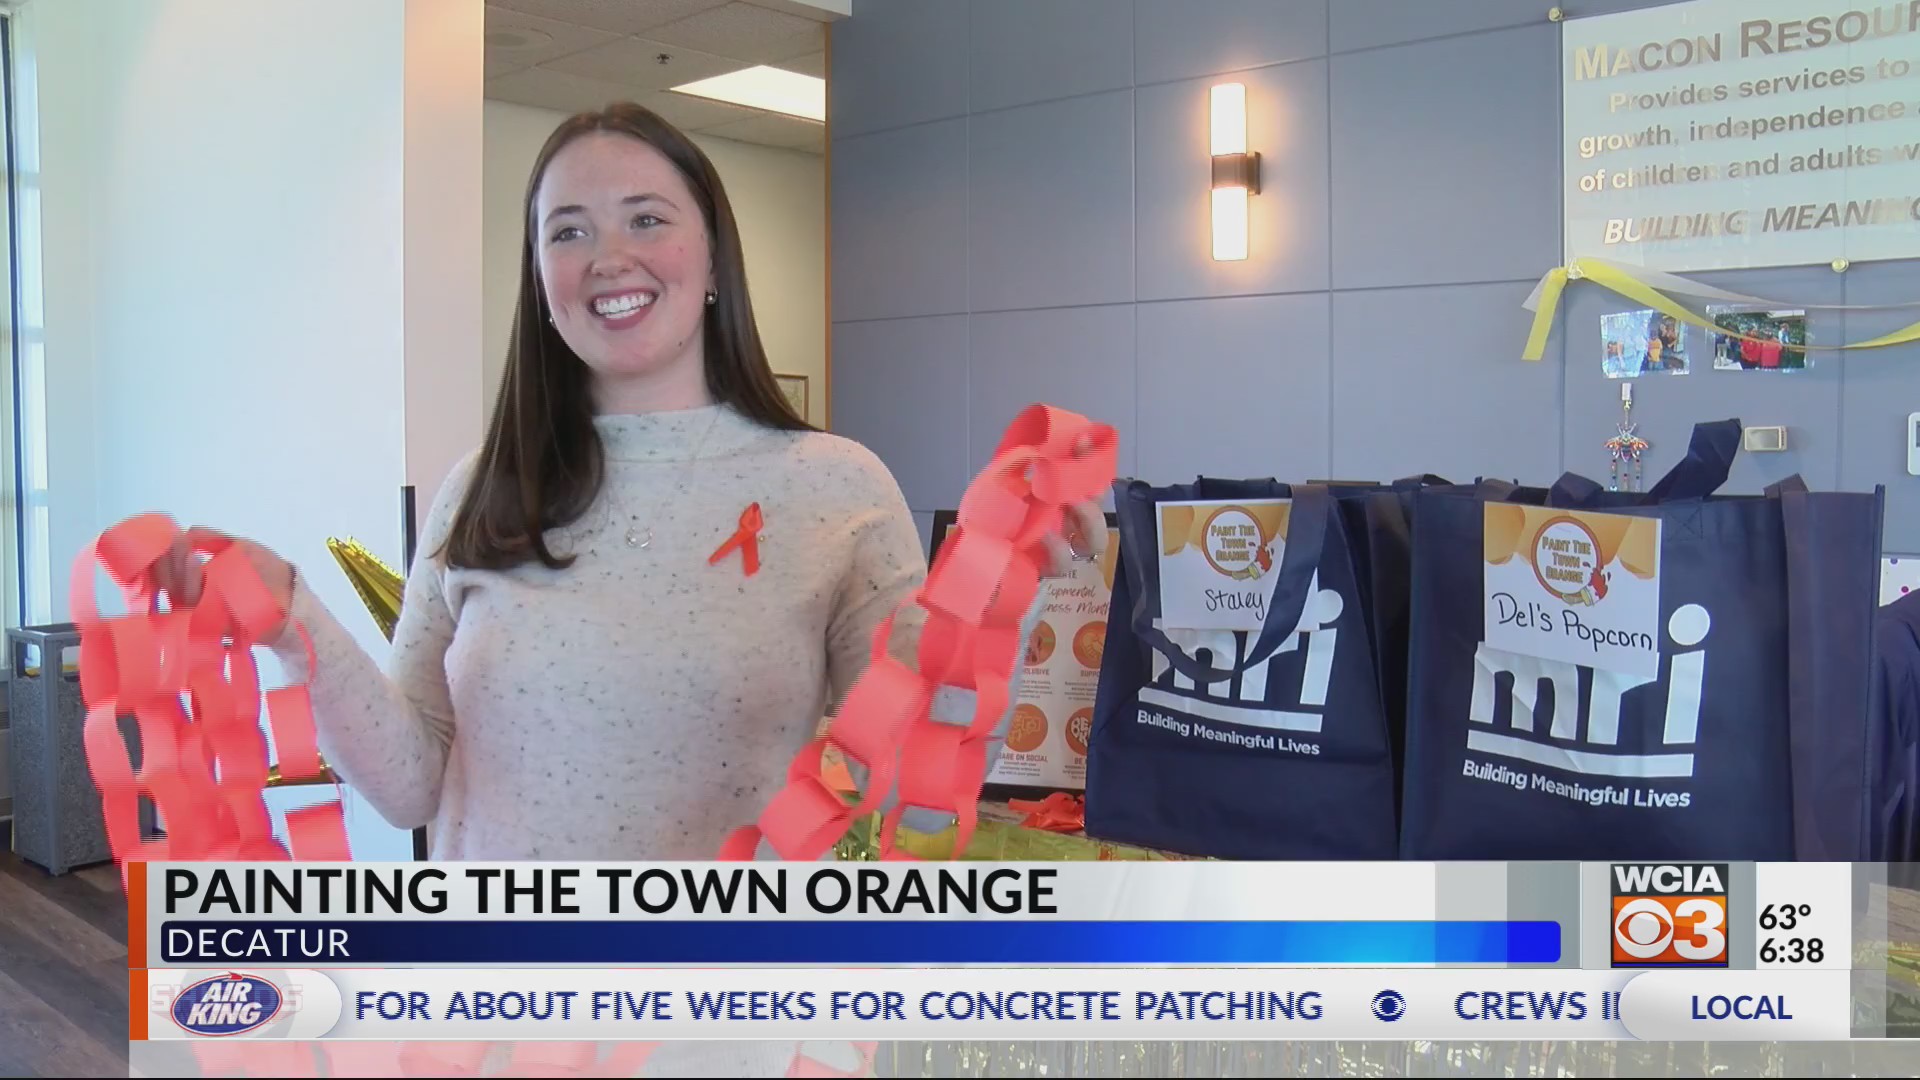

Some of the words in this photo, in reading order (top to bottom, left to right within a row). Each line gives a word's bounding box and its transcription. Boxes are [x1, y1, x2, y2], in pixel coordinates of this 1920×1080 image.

[1575, 33, 1721, 81] MACON
[1609, 82, 1728, 113] Provides
[1739, 68, 1865, 98] services
[1876, 58, 1910, 80] to
[1579, 125, 1679, 158] growth,
[1689, 101, 1906, 141] independence
[1579, 169, 1605, 192] of
[1612, 163, 1720, 190] children
[1728, 153, 1779, 179] and
[1789, 145, 1883, 173] adults
[1604, 209, 1749, 244] BUILDING
[1552, 552, 1580, 568] TOWN
[1573, 540, 1591, 555] THE
[1546, 566, 1583, 584] ORANGE
[1205, 589, 1265, 622] Staley
[1492, 592, 1553, 632] Del's
[1562, 609, 1653, 652] Popcorn
[1469, 603, 1712, 745] mri
[1137, 709, 1190, 737] Building
[1193, 724, 1275, 750] Meaningful
[1278, 737, 1321, 756] Lives
[1462, 759, 1528, 790] Building
[1531, 773, 1630, 806] Meaningful
[1634, 789, 1691, 808] Lives
